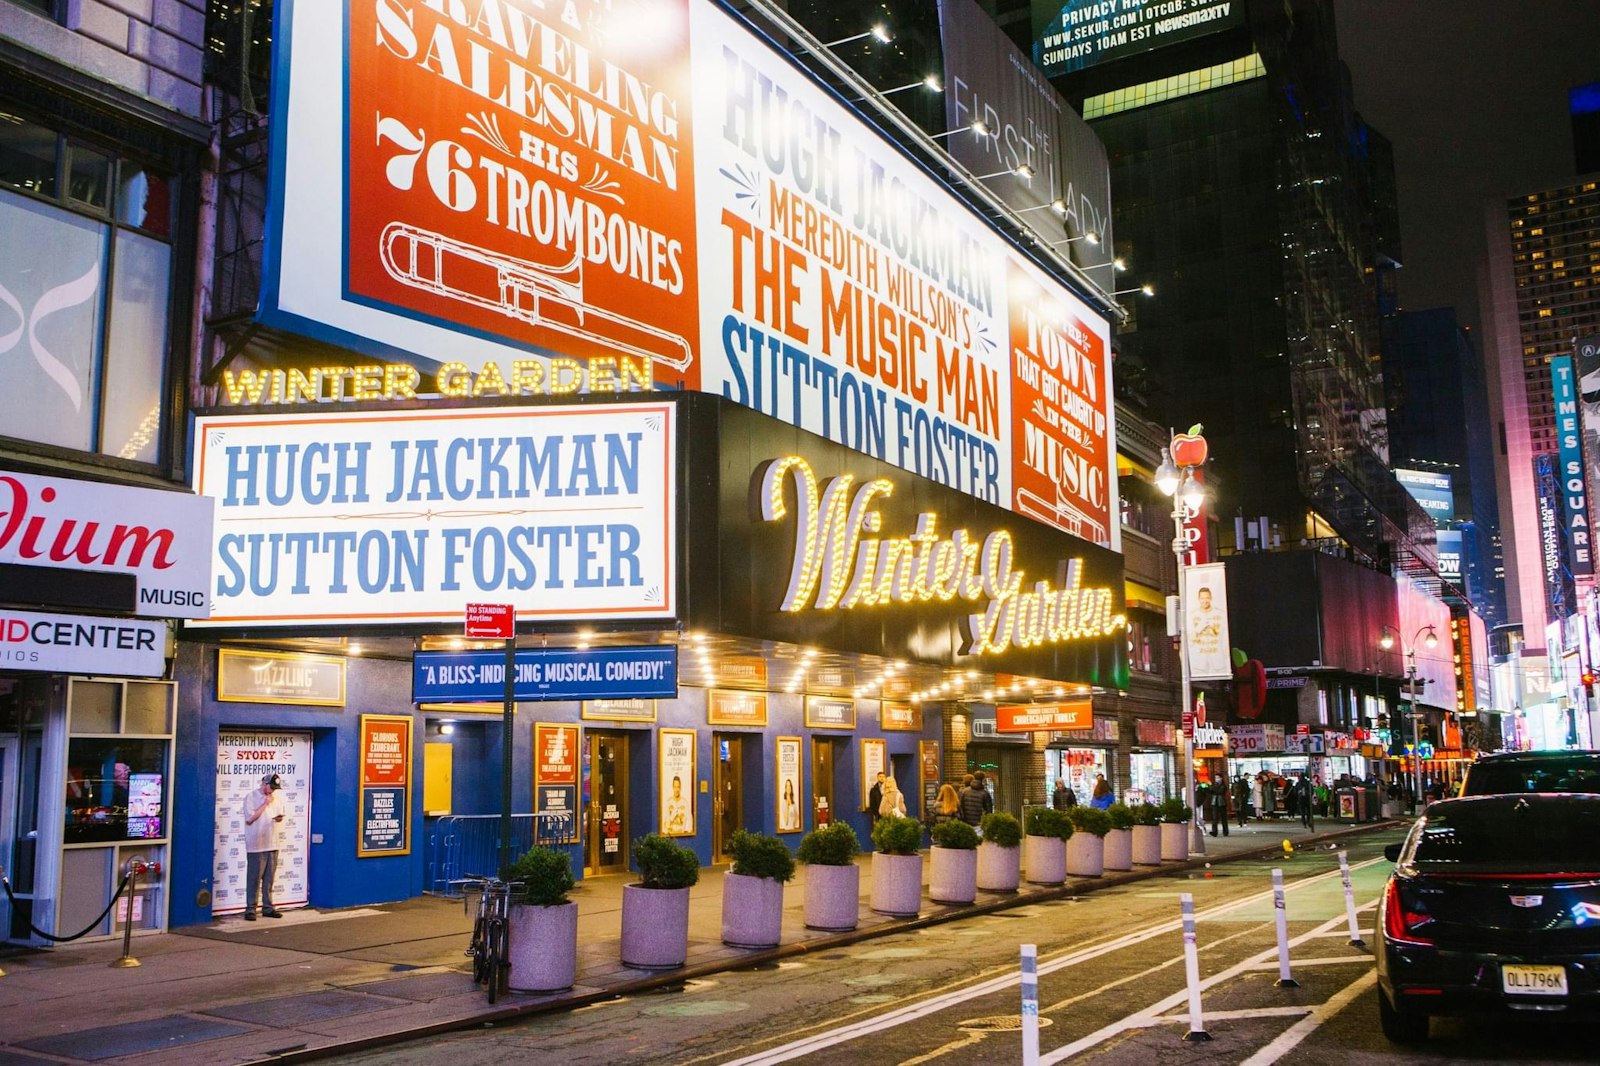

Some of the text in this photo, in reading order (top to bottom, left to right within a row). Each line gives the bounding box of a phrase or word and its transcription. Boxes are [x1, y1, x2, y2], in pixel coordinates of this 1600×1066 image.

[1043, 0, 1187, 49] WWW.SEKUR.COM OTCQB:
[1062, 0, 1116, 28] PRIVACY
[413, 0, 679, 141] RAVELING
[1043, 42, 1092, 66] SUNDAYS
[1096, 34, 1127, 51] 10AM
[1131, 24, 1152, 42] EST
[376, 0, 679, 191] SALESMAN
[519, 130, 579, 183] HIS
[954, 75, 1035, 189] FIRST
[1028, 118, 1050, 154] THE
[376, 110, 684, 296] 76 TROMBONES
[722, 44, 993, 319] HUGH JACKMAN
[1049, 163, 1107, 254] LADY
[769, 179, 971, 349] MEREDITH WILLSON'S
[720, 208, 1001, 442] THE MUSIC MAN
[1022, 308, 1098, 402] TOWN
[222, 355, 655, 405] WINTER GARDEN
[721, 315, 1001, 504] SUTTON FOSTER
[1015, 348, 1105, 439] THAT GOT CAUGHT UP
[1557, 367, 1577, 449] TIMES
[1046, 406, 1082, 444] IN THE
[222, 432, 643, 507] HUGH JACKMAN
[1022, 418, 1107, 512] MUSIC.
[1540, 497, 1549, 528] EAGLE
[1547, 508, 1559, 569] OUTFITTERS
[1566, 461, 1589, 563] SQUARE
[217, 523, 644, 597] SUTTON FOSTER
[762, 456, 1127, 656] Winter Garden
[1438, 560, 1460, 572] OW
[1543, 530, 1555, 583] AMERICAN
[140, 588, 204, 607] MUSIC
[469, 614, 492, 622] Anytime
[0, 650, 39, 662] IOS
[548, 662, 602, 682] MUSICAL
[218, 736, 294, 747] MEREDITH WILLSON'S
[234, 764, 243, 775] BE
[244, 764, 286, 775] PERFORMED
[287, 764, 296, 775] BY
[236, 750, 276, 760] STORY
